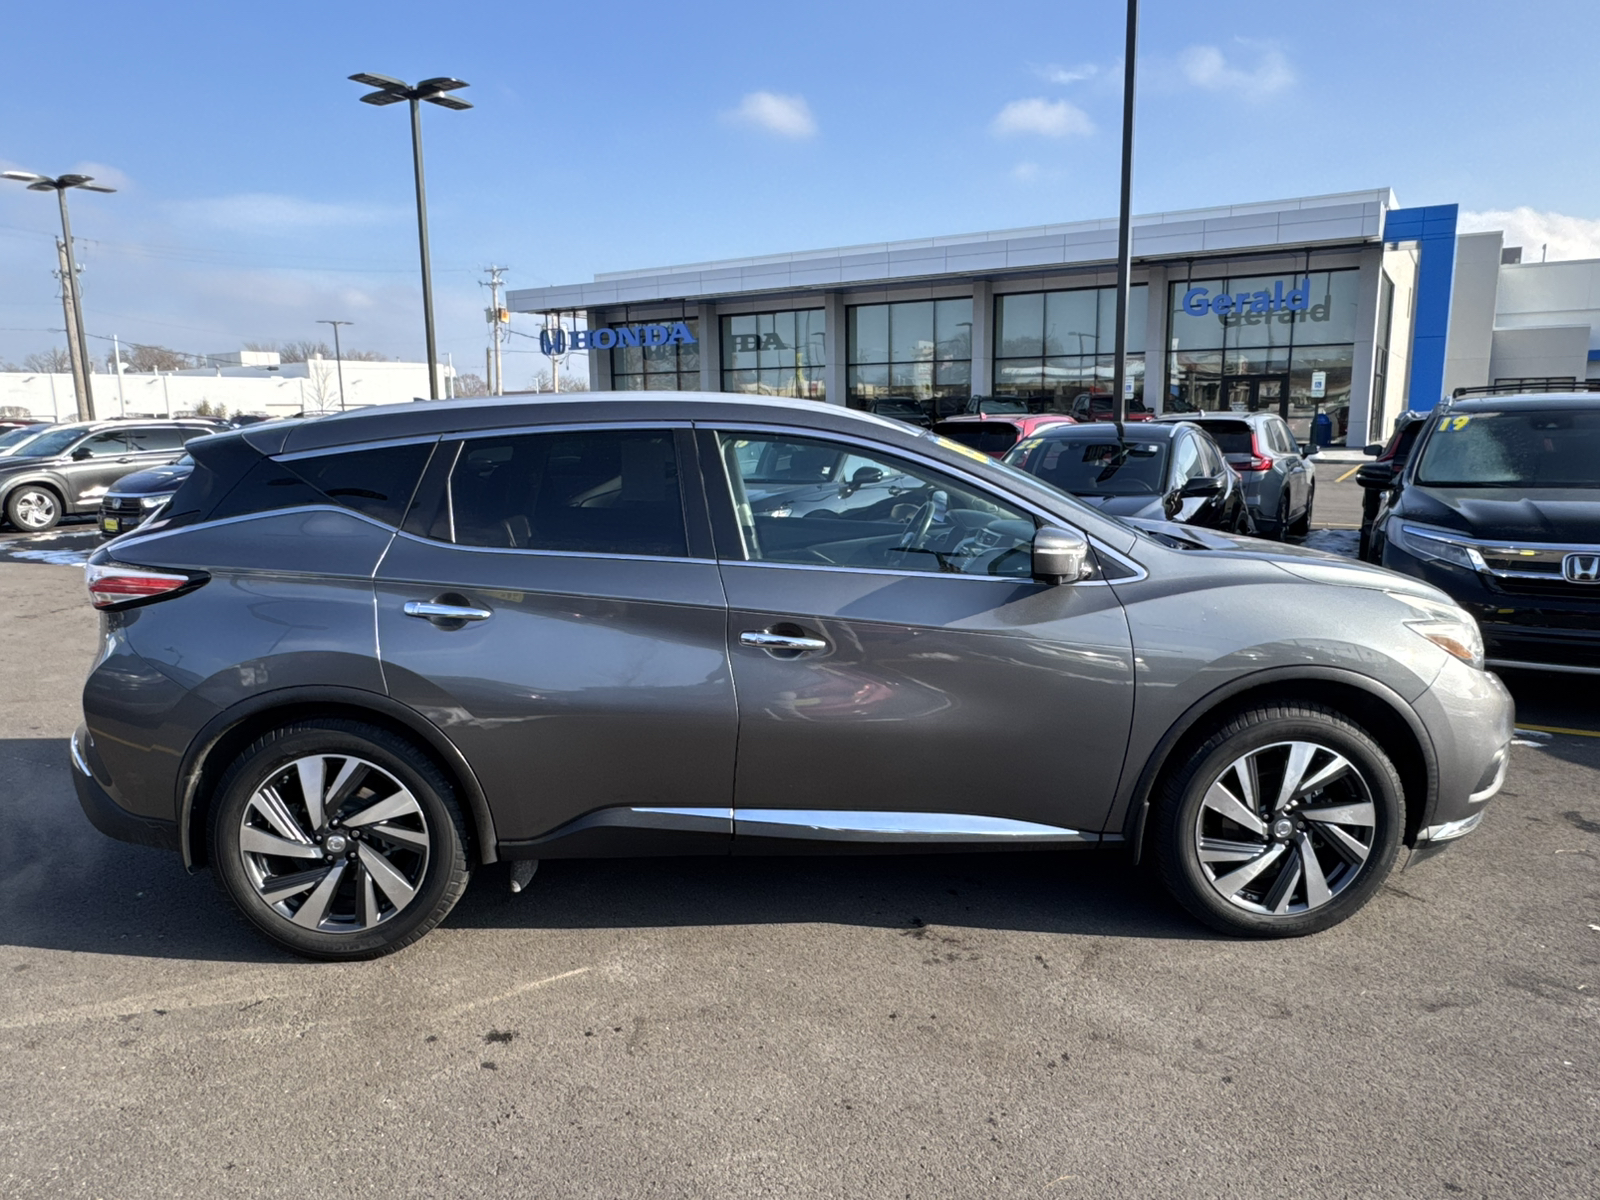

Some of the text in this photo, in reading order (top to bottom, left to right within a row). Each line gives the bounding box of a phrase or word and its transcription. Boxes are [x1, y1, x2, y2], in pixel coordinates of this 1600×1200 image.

[1183, 278, 1310, 316] Gerald
[568, 323, 697, 350] HONDA
[1438, 416, 1469, 431] 19
